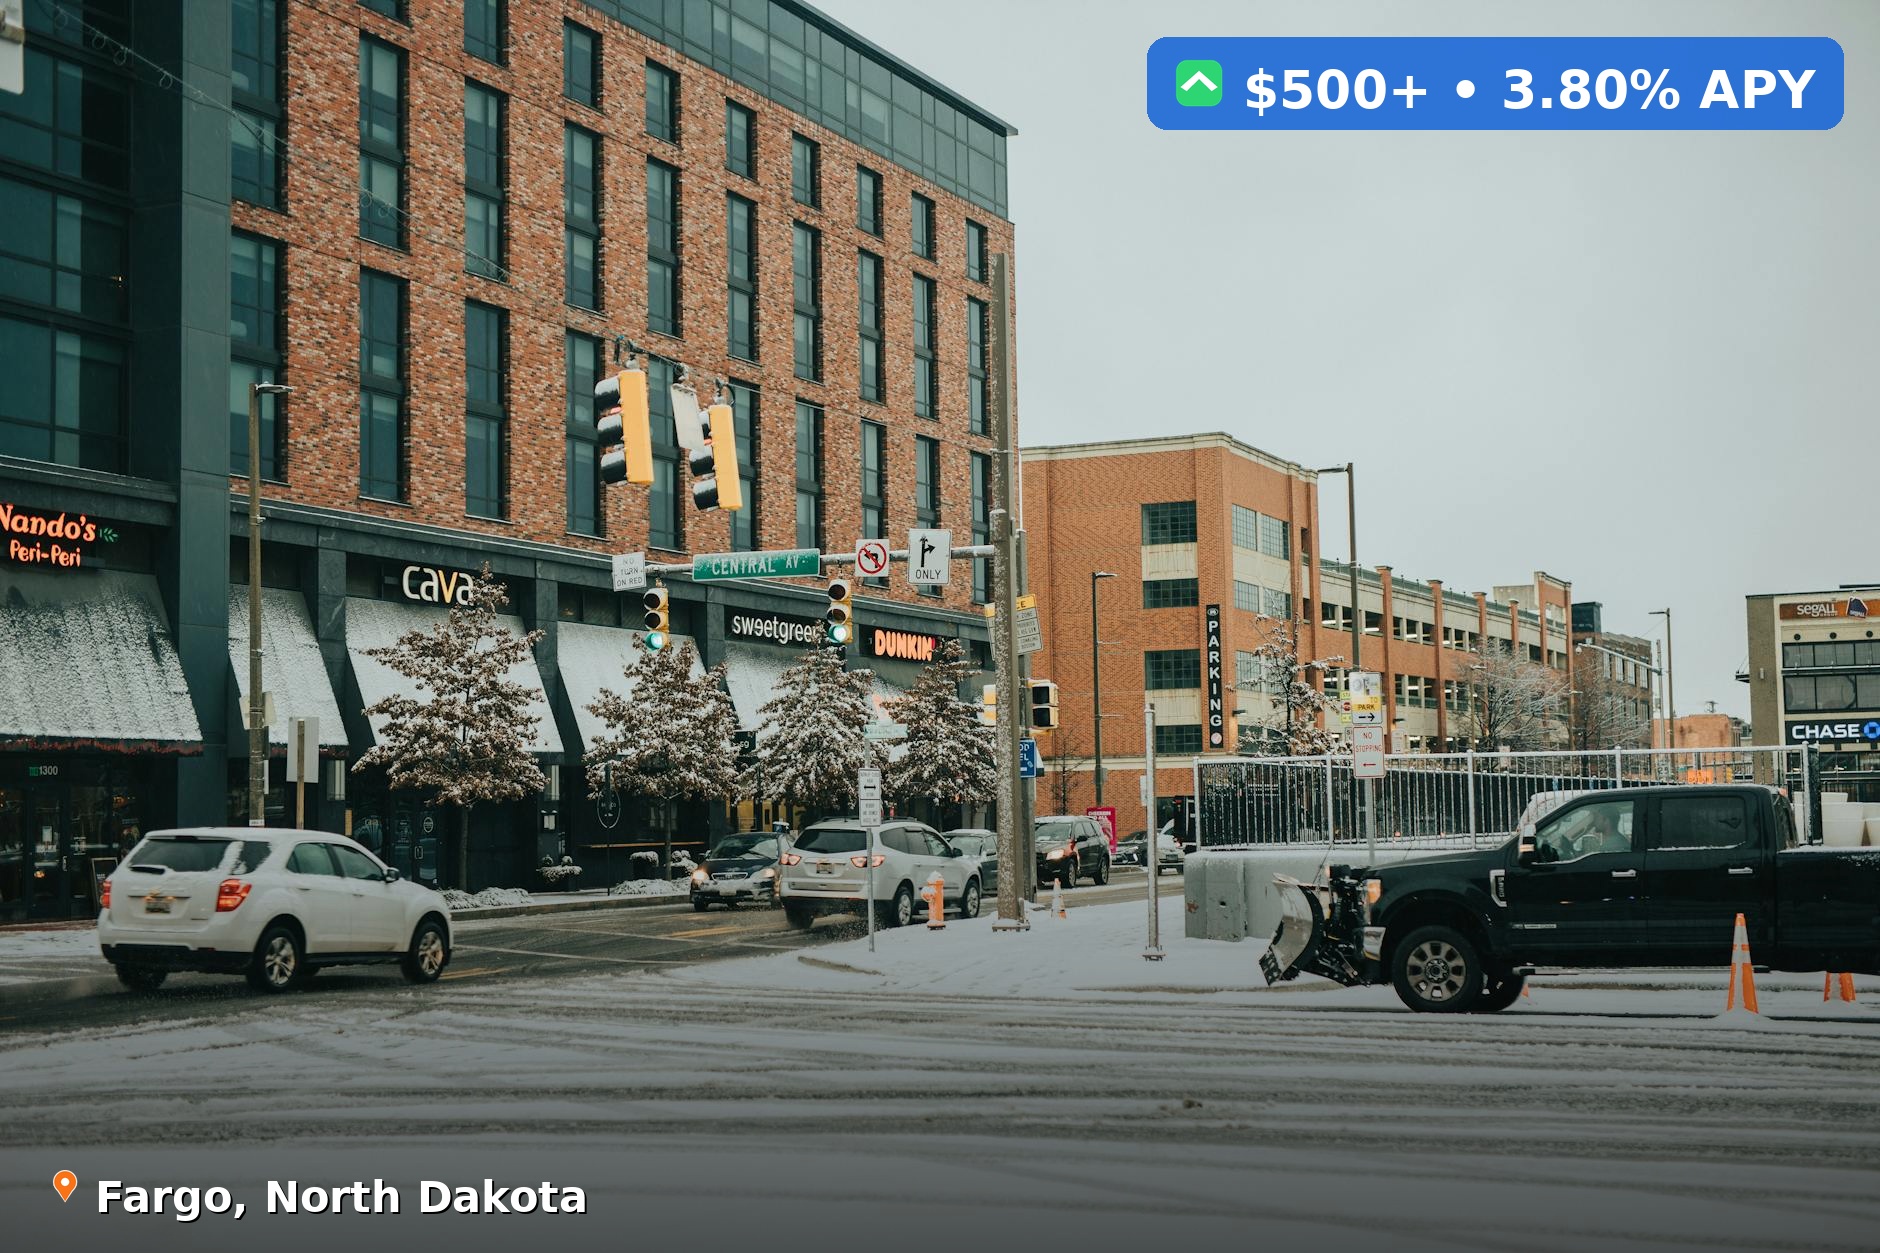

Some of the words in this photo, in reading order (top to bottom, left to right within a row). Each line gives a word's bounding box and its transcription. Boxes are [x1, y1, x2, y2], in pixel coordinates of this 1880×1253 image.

[0, 503, 96, 541] Nando's
[10, 539, 81, 567] Peri-Peri
[620, 567, 639, 576] TURN
[711, 557, 776, 576] CENTRAL
[915, 569, 941, 580] ONLY
[617, 579, 627, 587] ON
[629, 577, 643, 585] RED
[732, 615, 820, 644] sweetgree
[1208, 620, 1222, 727] PARKING
[1357, 703, 1376, 711] PARK
[1363, 732, 1373, 740] NO
[1792, 723, 1860, 740] CHASE
[1355, 744, 1382, 753] STOPPING
[40, 765, 59, 776] 1300
